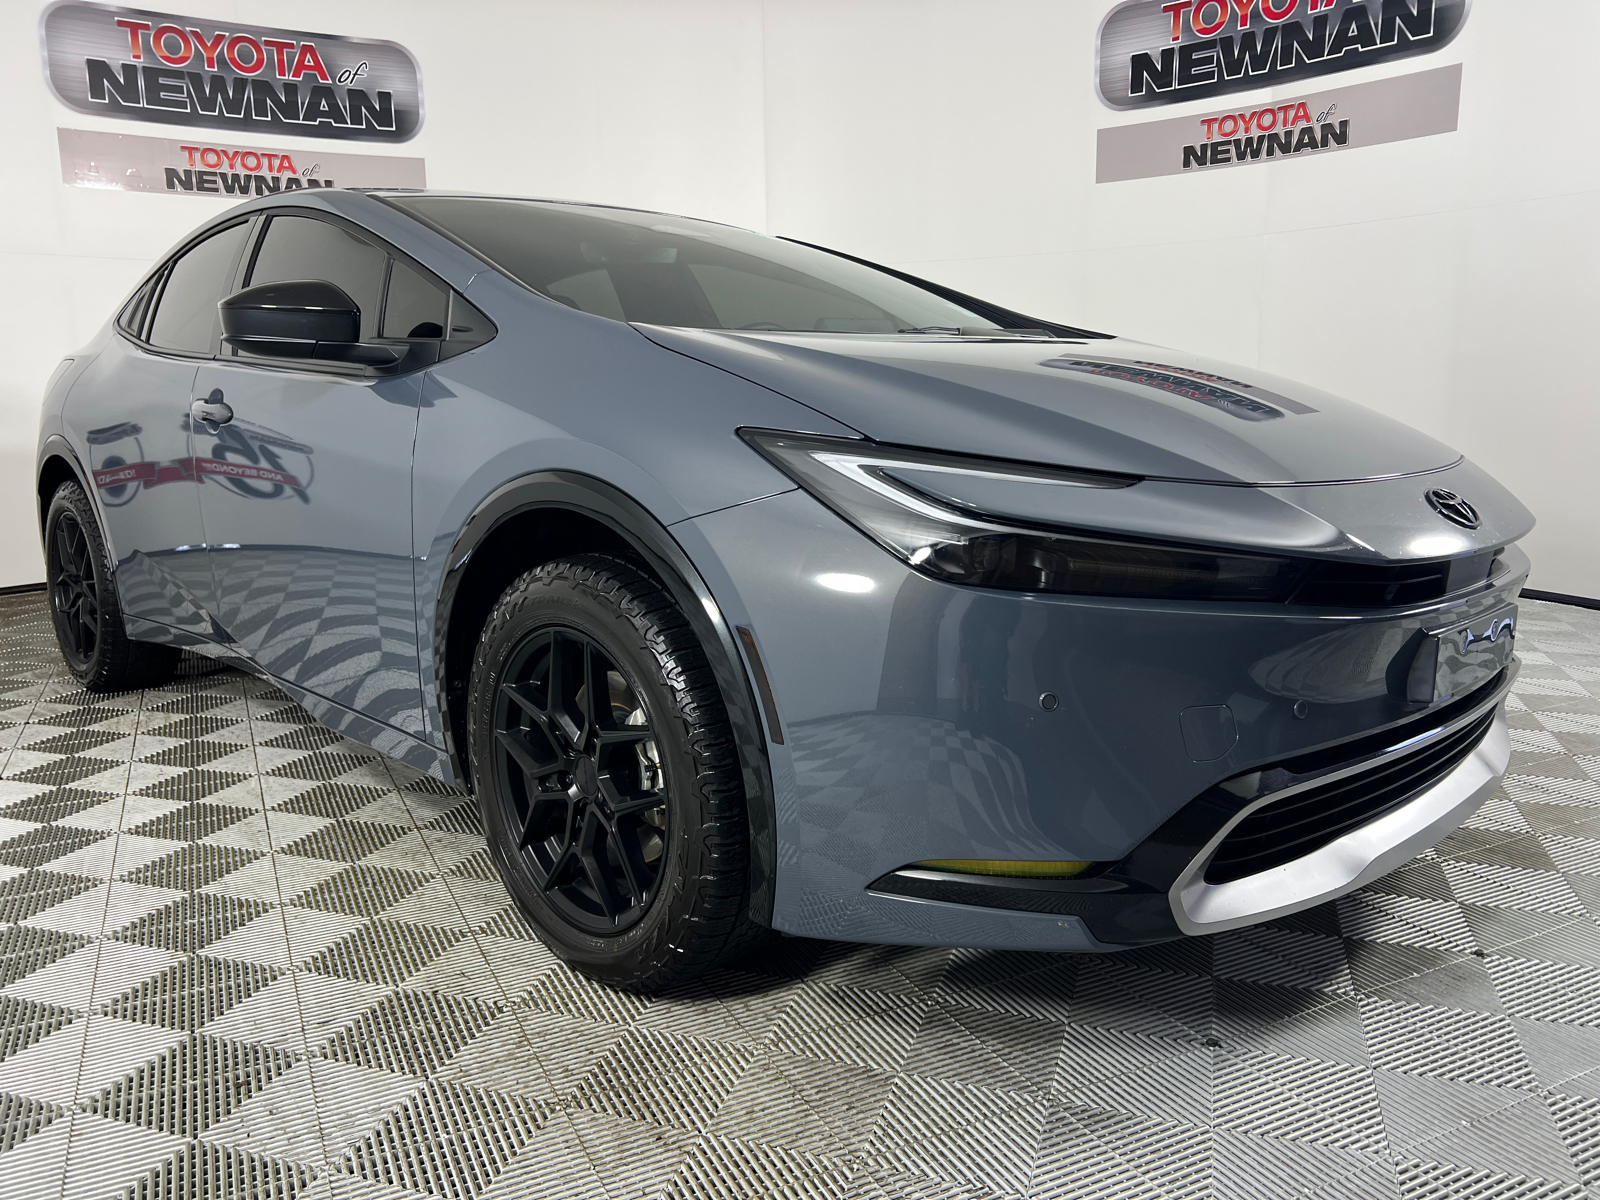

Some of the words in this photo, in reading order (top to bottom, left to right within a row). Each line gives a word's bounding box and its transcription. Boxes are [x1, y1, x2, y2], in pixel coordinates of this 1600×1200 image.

[1162, 0, 1350, 43] TOYO
[115, 17, 332, 84] TOYOTA
[336, 61, 369, 86] of
[1128, 0, 1435, 97] NEWNAN
[85, 57, 396, 131] NEWNAN
[1181, 118, 1350, 170] NEWNAN
[1200, 101, 1312, 141] TOYOTA
[1316, 103, 1337, 124] of
[179, 145, 299, 175] TOYOTA
[302, 163, 320, 178] of
